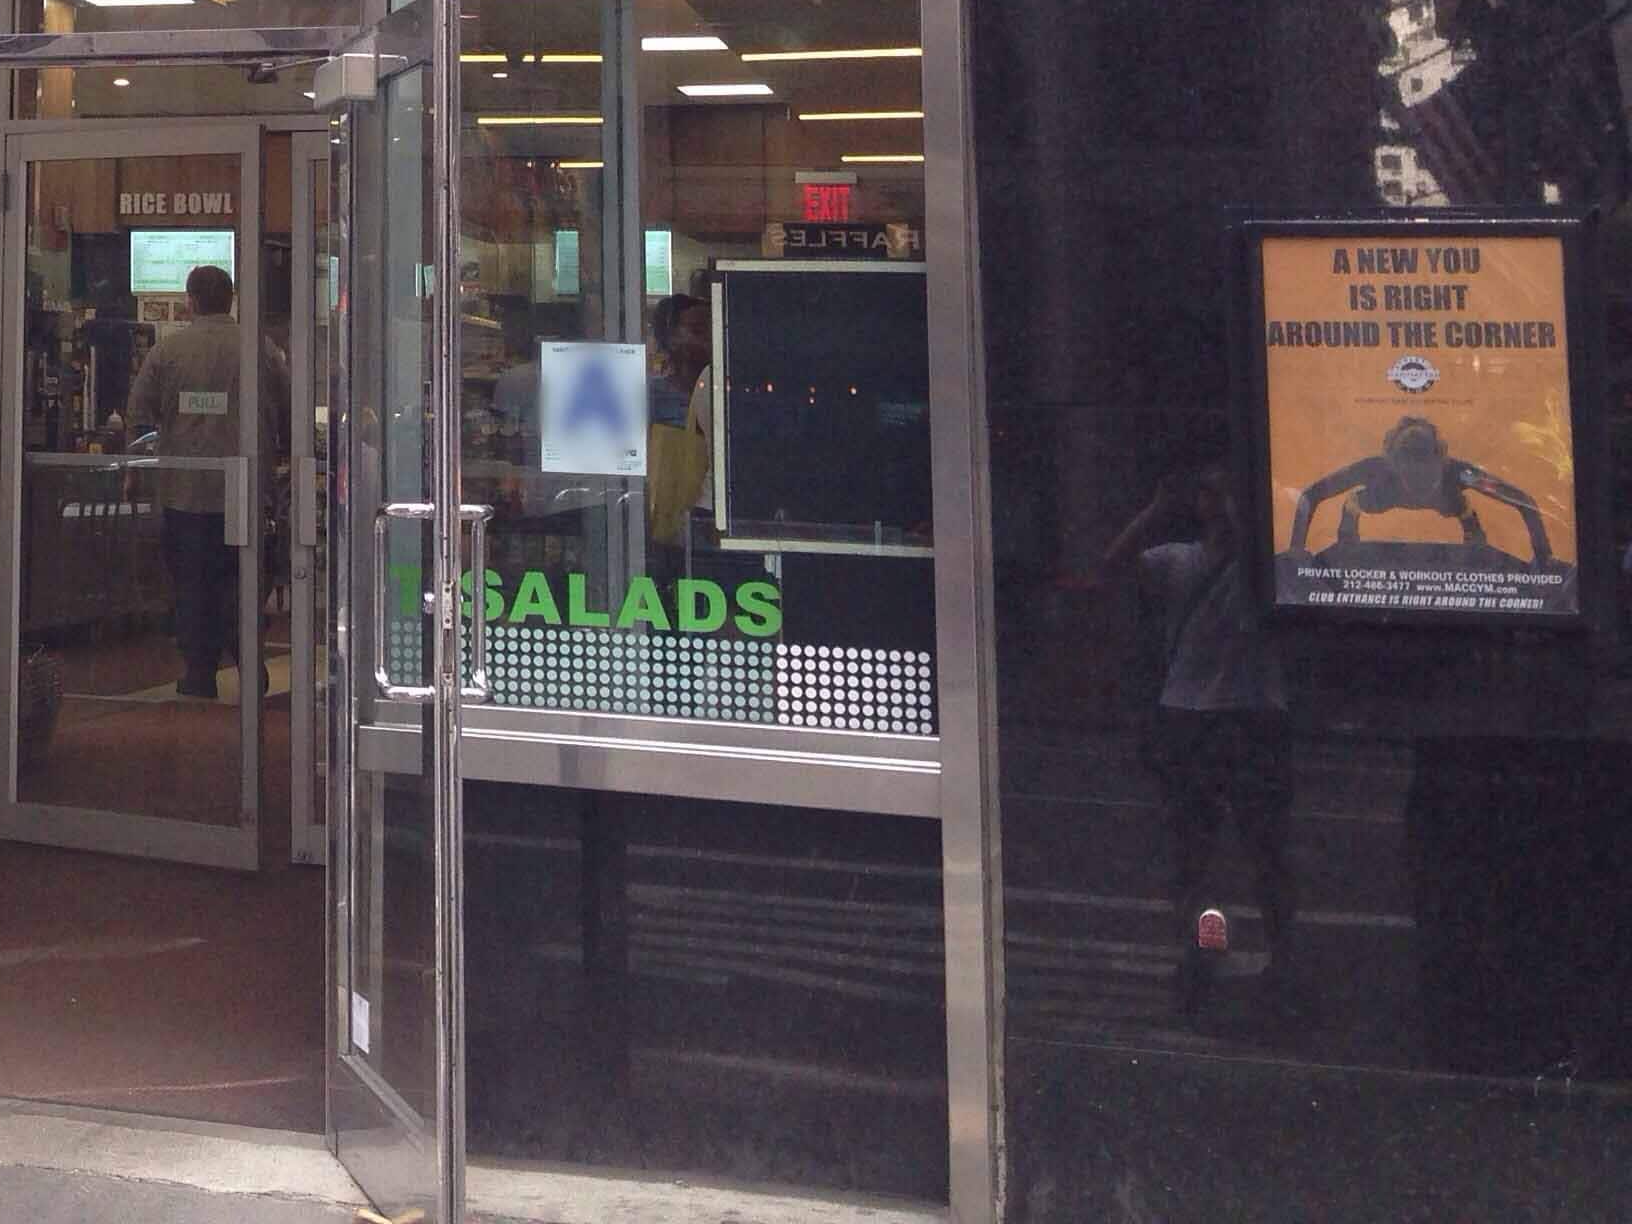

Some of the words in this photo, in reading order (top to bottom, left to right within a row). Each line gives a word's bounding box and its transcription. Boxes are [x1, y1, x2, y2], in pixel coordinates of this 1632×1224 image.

[119, 192, 168, 215] RICE
[173, 192, 234, 215] BOWL
[804, 184, 850, 221] EXIT
[1333, 248, 1352, 274] A
[1358, 248, 1419, 274] NEW
[1425, 247, 1482, 274] YOU
[1349, 284, 1377, 311] IS
[1383, 284, 1470, 311] RIGHT
[1267, 321, 1381, 348] AROUND
[1386, 321, 1439, 348] THE
[1445, 321, 1557, 349] CORNER
[1297, 567, 1342, 578] PRIVATE
[1344, 569, 1386, 580] LOCKER
[1399, 571, 1453, 582] WORKOUT
[1455, 572, 1504, 584] CLOTHES
[1507, 574, 1563, 585] PROVIDED
[461, 566, 784, 638] SALADS
[1308, 591, 1334, 603] CLUB
[1336, 592, 1387, 605] ENTRANCE
[1389, 595, 1400, 605] IS
[1402, 595, 1432, 606] RIGHT
[1434, 596, 1476, 608] AROUND
[1478, 597, 1497, 608] THE
[1499, 598, 1544, 609] CORNER!
